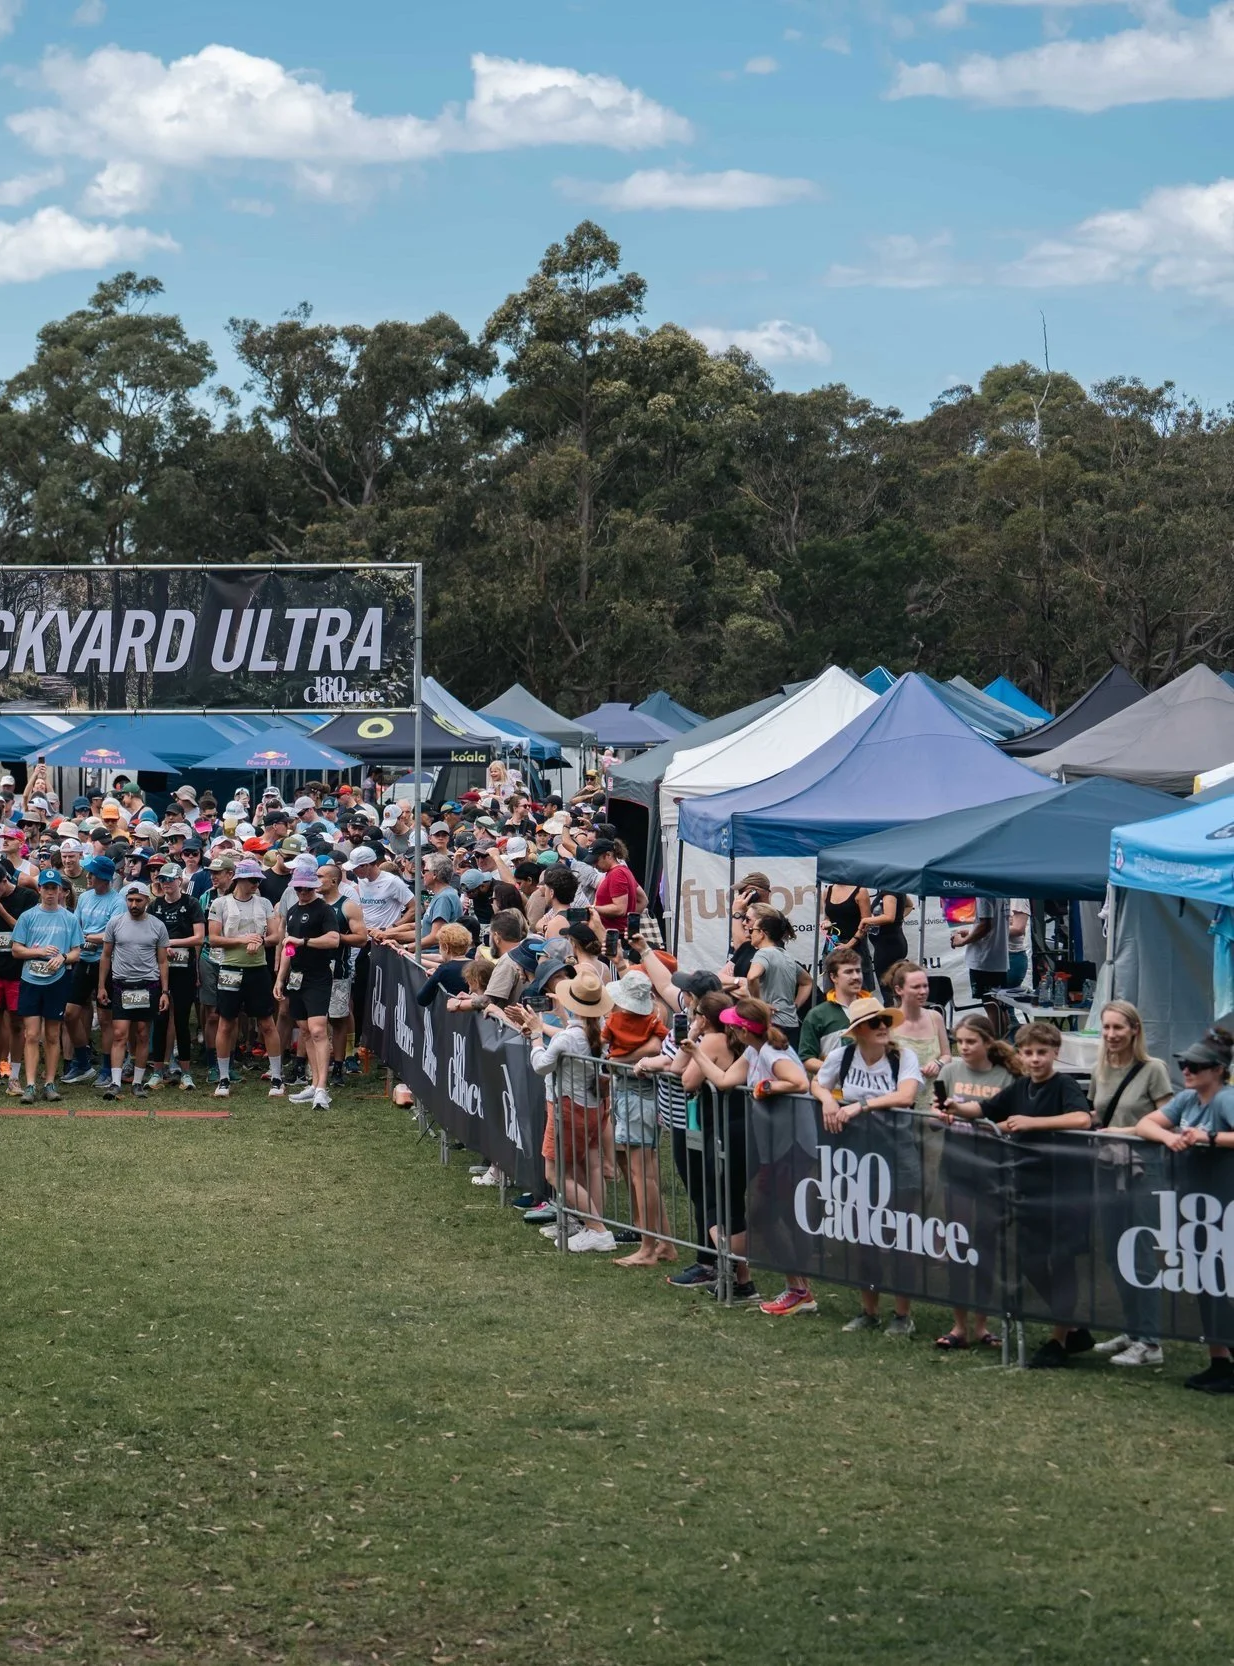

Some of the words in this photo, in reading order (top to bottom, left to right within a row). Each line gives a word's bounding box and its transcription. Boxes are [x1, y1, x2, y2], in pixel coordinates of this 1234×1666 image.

[211, 607, 383, 673] ULTRA
[303, 686, 385, 703] Cadence.
[313, 676, 347, 697] 180
[80, 756, 102, 764] Red
[105, 757, 126, 765] Bull
[943, 880, 975, 889] CLASSIC
[815, 1144, 892, 1210] 180
[793, 1177, 980, 1267] Cadence.
[1151, 1190, 1234, 1257] 18
